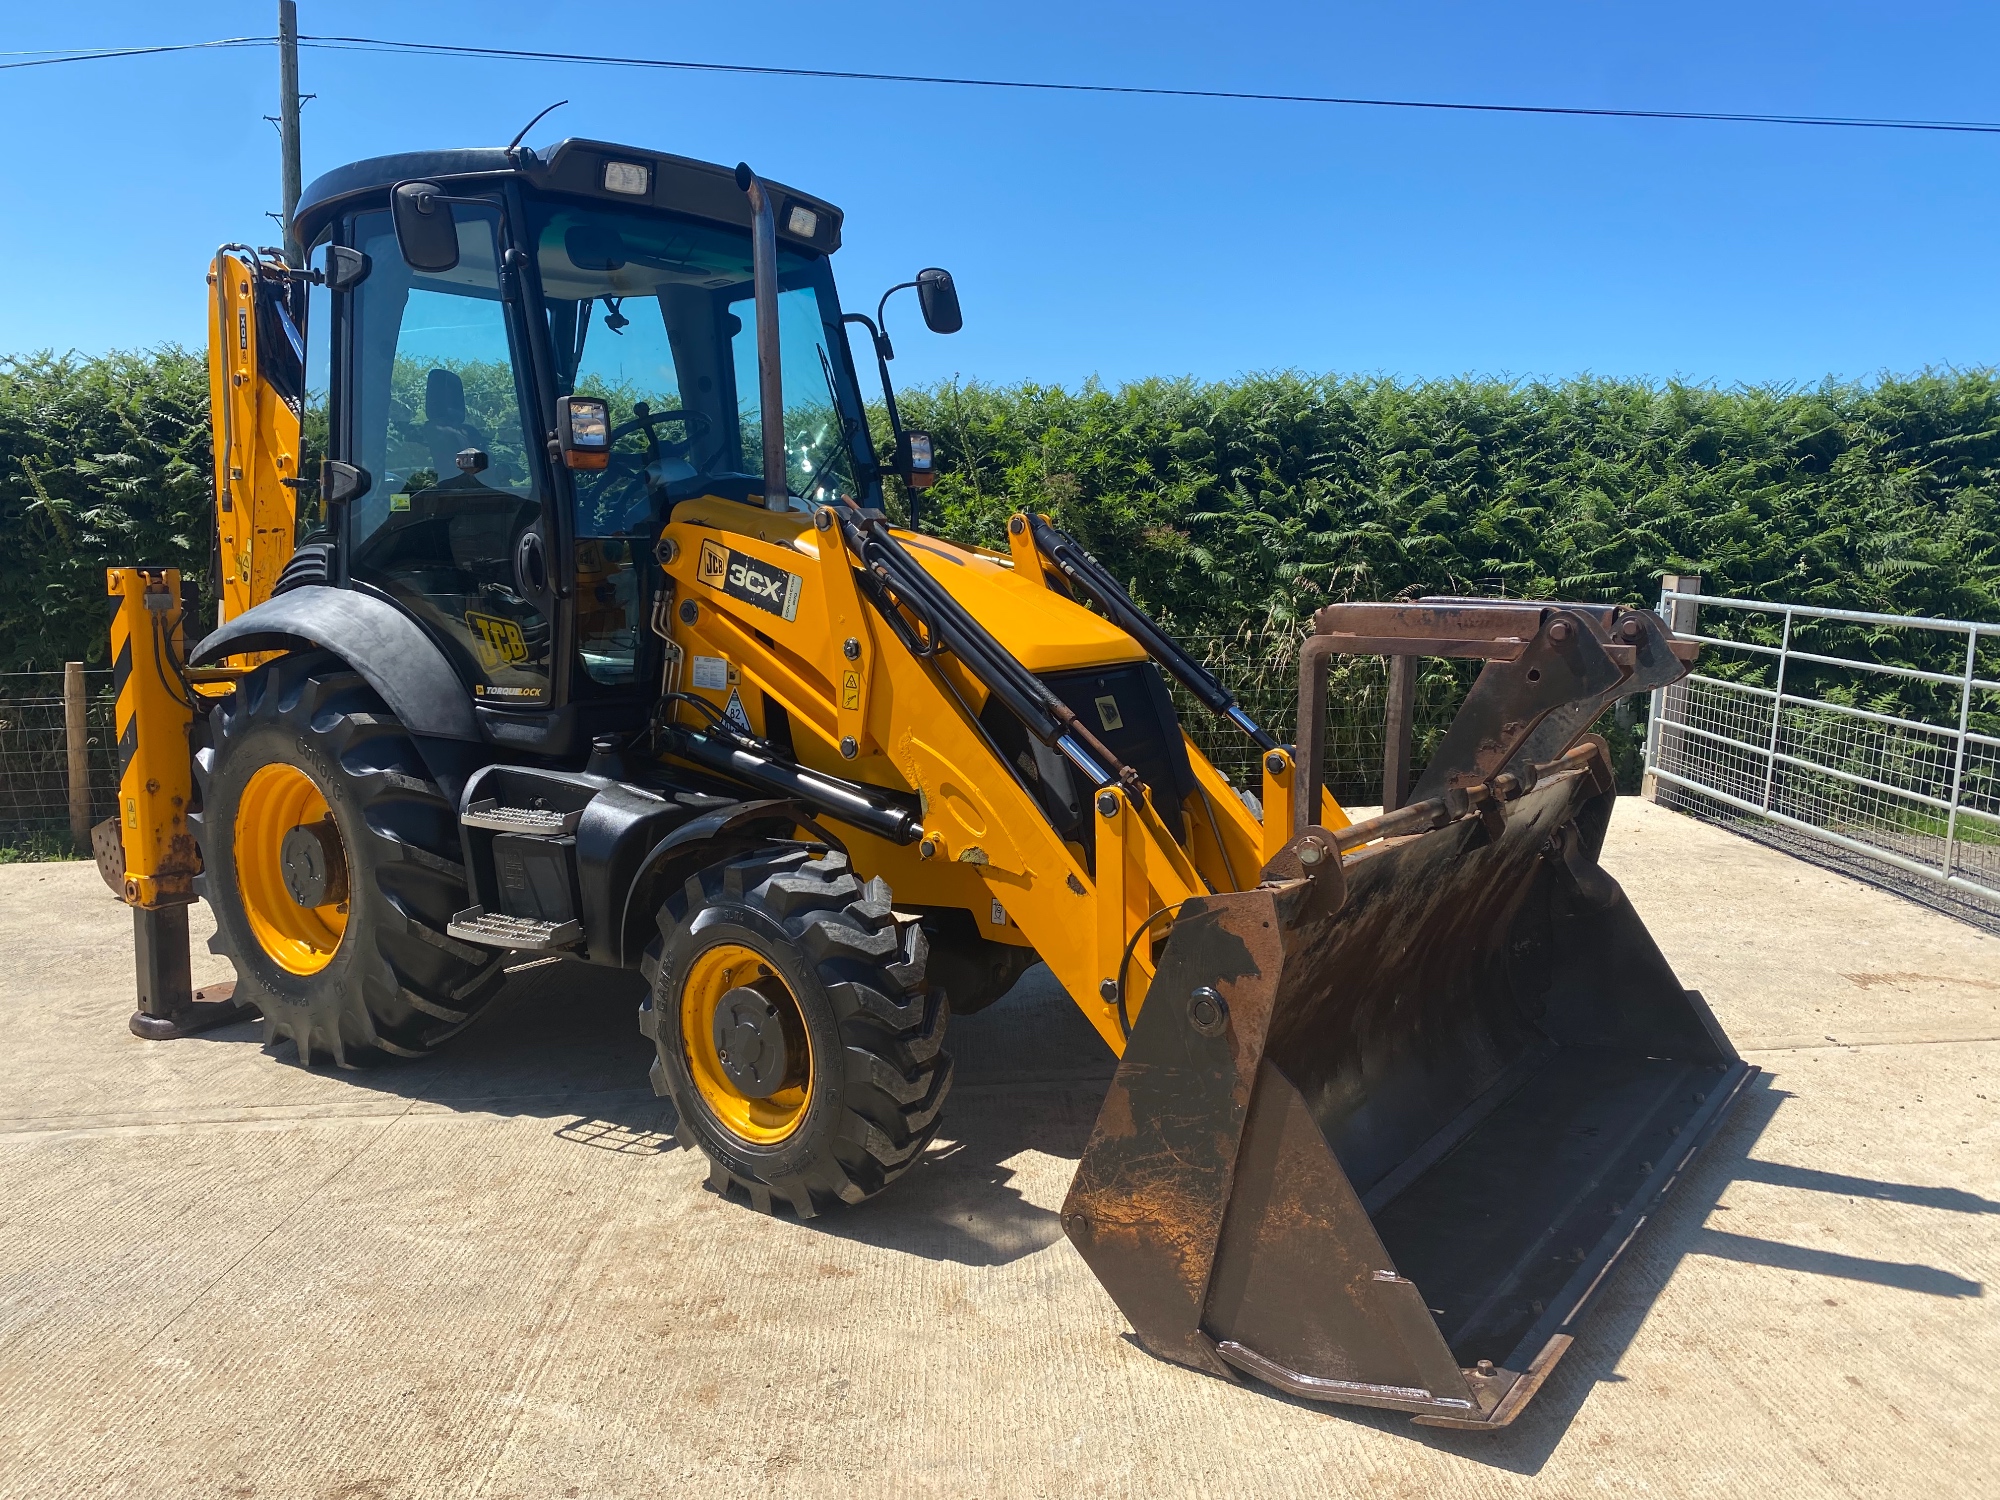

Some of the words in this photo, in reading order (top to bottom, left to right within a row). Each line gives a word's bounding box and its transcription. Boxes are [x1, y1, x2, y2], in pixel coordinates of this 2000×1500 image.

[707, 552, 723, 575] JCB
[729, 563, 783, 603] 3CX
[475, 618, 524, 667] JCB
[486, 686, 541, 697] TORQUELOCK
